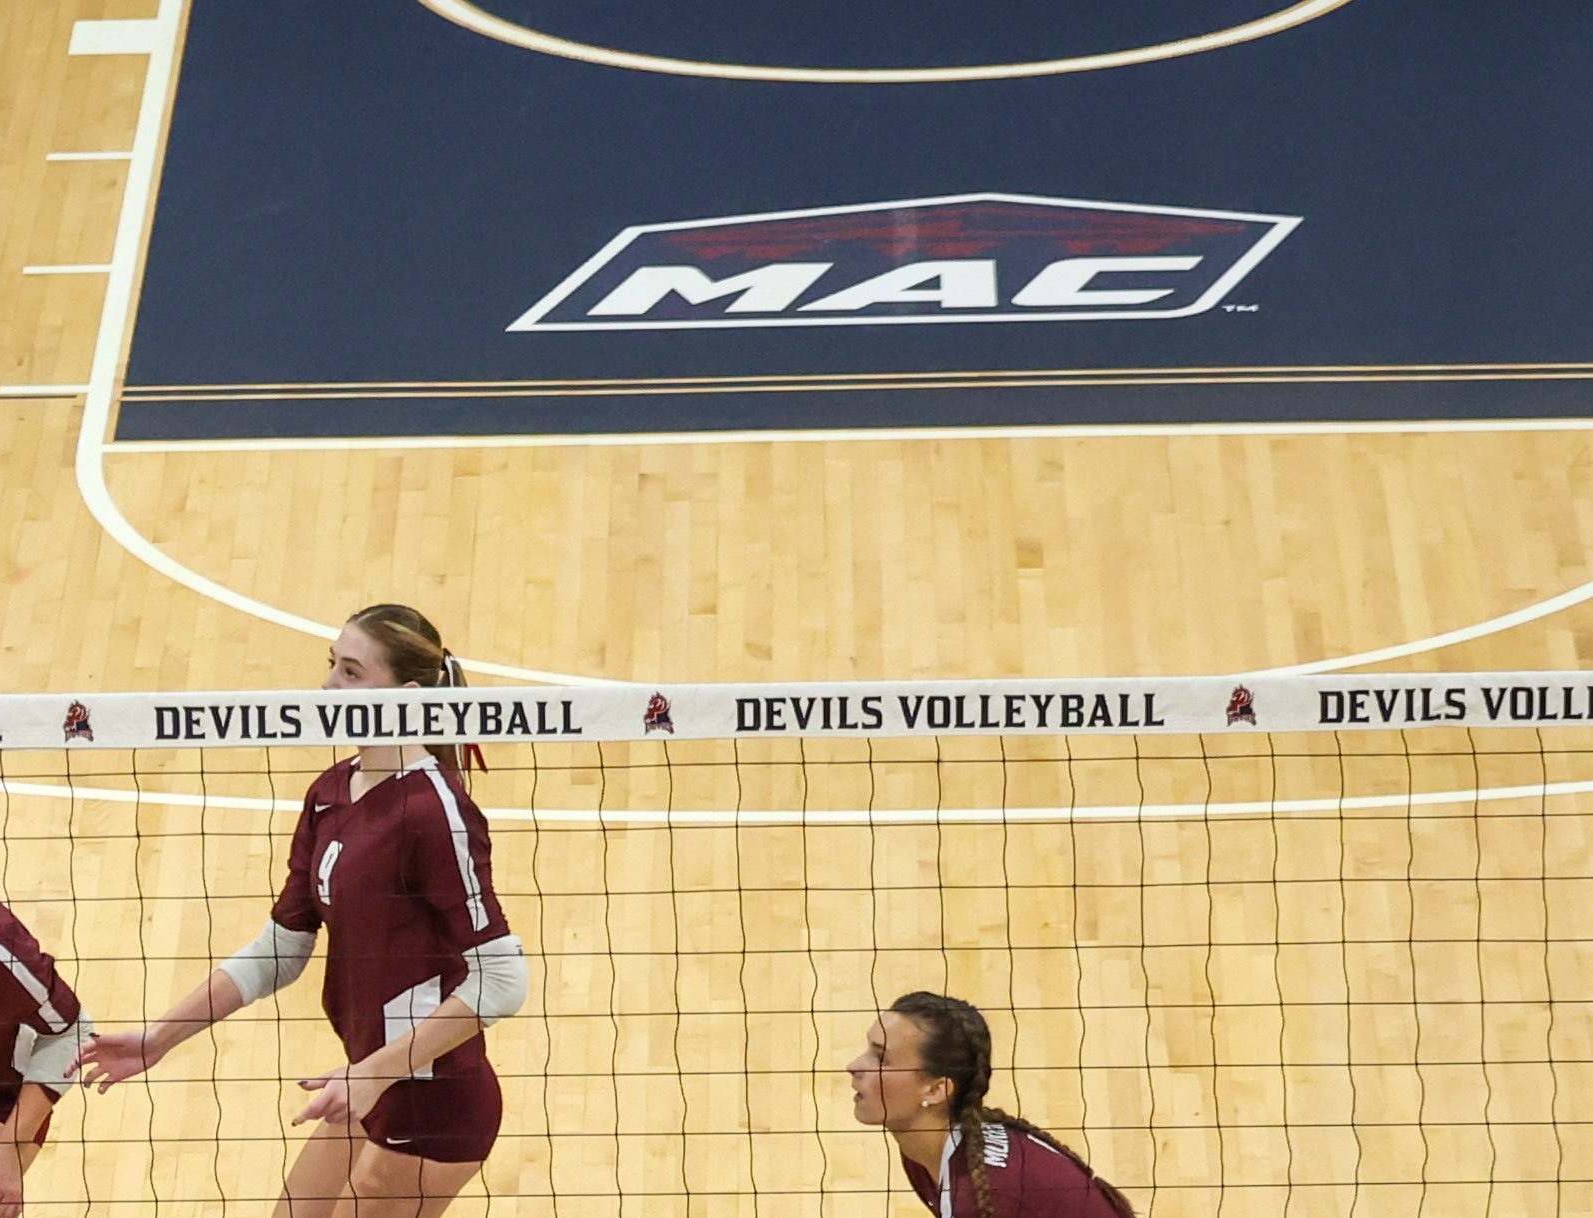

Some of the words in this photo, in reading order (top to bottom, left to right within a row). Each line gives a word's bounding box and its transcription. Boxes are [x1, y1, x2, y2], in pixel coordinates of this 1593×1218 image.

[587, 255, 1205, 316] MAC
[154, 705, 302, 740] DEVILS
[316, 700, 582, 739] VOLLEYBALL
[735, 695, 883, 732] DEVILS
[897, 693, 1165, 730] VOLLEYBALL
[1319, 686, 1466, 724] DEVILS
[317, 839, 344, 906] 9
